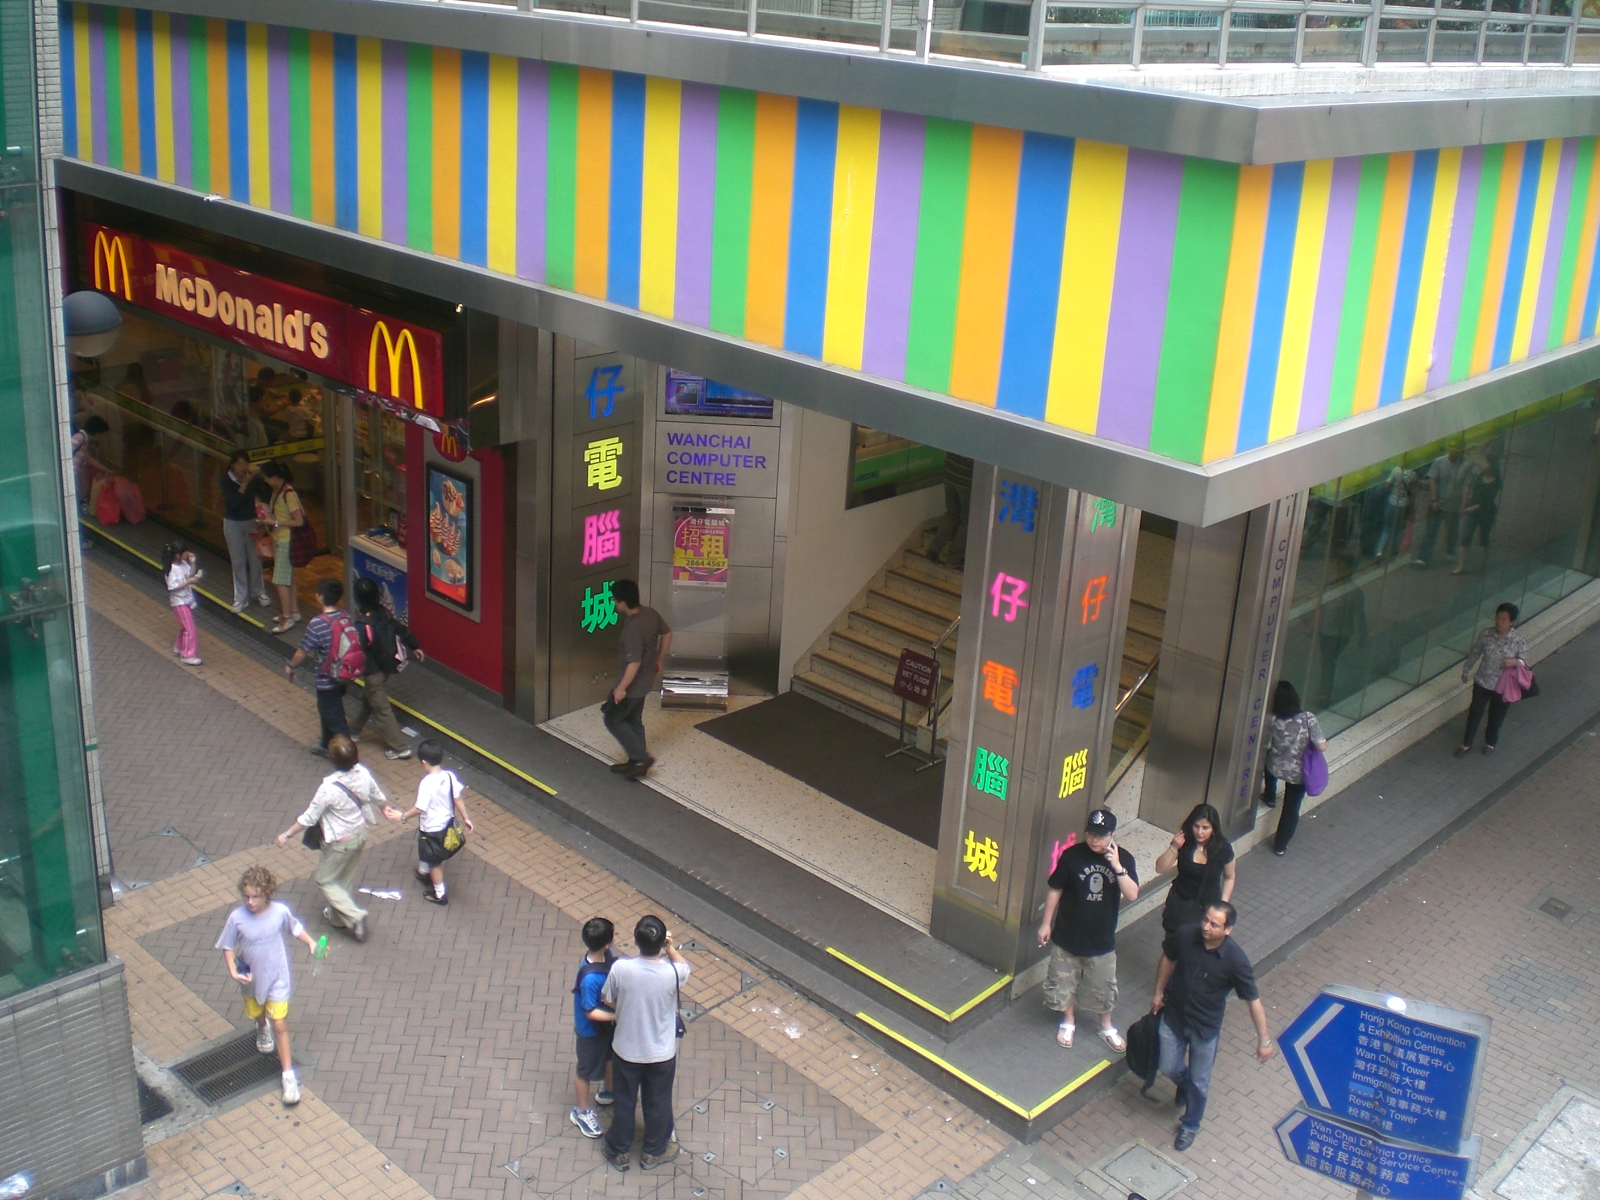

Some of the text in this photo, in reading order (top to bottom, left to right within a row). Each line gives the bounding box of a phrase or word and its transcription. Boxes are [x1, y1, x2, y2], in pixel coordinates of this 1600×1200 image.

[155, 263, 329, 359] McDonald's
[667, 432, 751, 450] WANCHAI
[666, 451, 767, 469] COMPUTER
[666, 470, 736, 486] CENTRE
[686, 559, 726, 568] 2864 4567
[1258, 539, 1287, 681] COMPUTER
[902, 670, 930, 686] WET FLOOR
[905, 659, 932, 674] CAUTION
[964, 480, 1038, 882] 灣仔電腦城
[1240, 698, 1262, 797] CENTRE
[1078, 865, 1116, 884] A BATHING
[1086, 893, 1104, 901] APE
[1358, 1023, 1446, 1057] & Exhibition Centre
[1360, 1010, 1467, 1049] Hong Kong Convention
[1355, 1047, 1431, 1078] Wan Chai Tower
[1358, 1035, 1456, 1073] 香港會議展覽中心
[1352, 1070, 1403, 1096] Immigration
[1405, 1088, 1435, 1104] Tower
[1354, 1058, 1427, 1091] 灣仔政府大樓
[1348, 1094, 1418, 1125] Revenue Tower
[1375, 1090, 1448, 1121] 入境事務大樓
[1310, 1120, 1432, 1165] Wan Chai District Office
[1310, 1128, 1459, 1178] Public Enquiry Service Centre
[1304, 1154, 1391, 1196] 諮詢服務中心
[1307, 1139, 1410, 1186] 灣仔民政事務處
